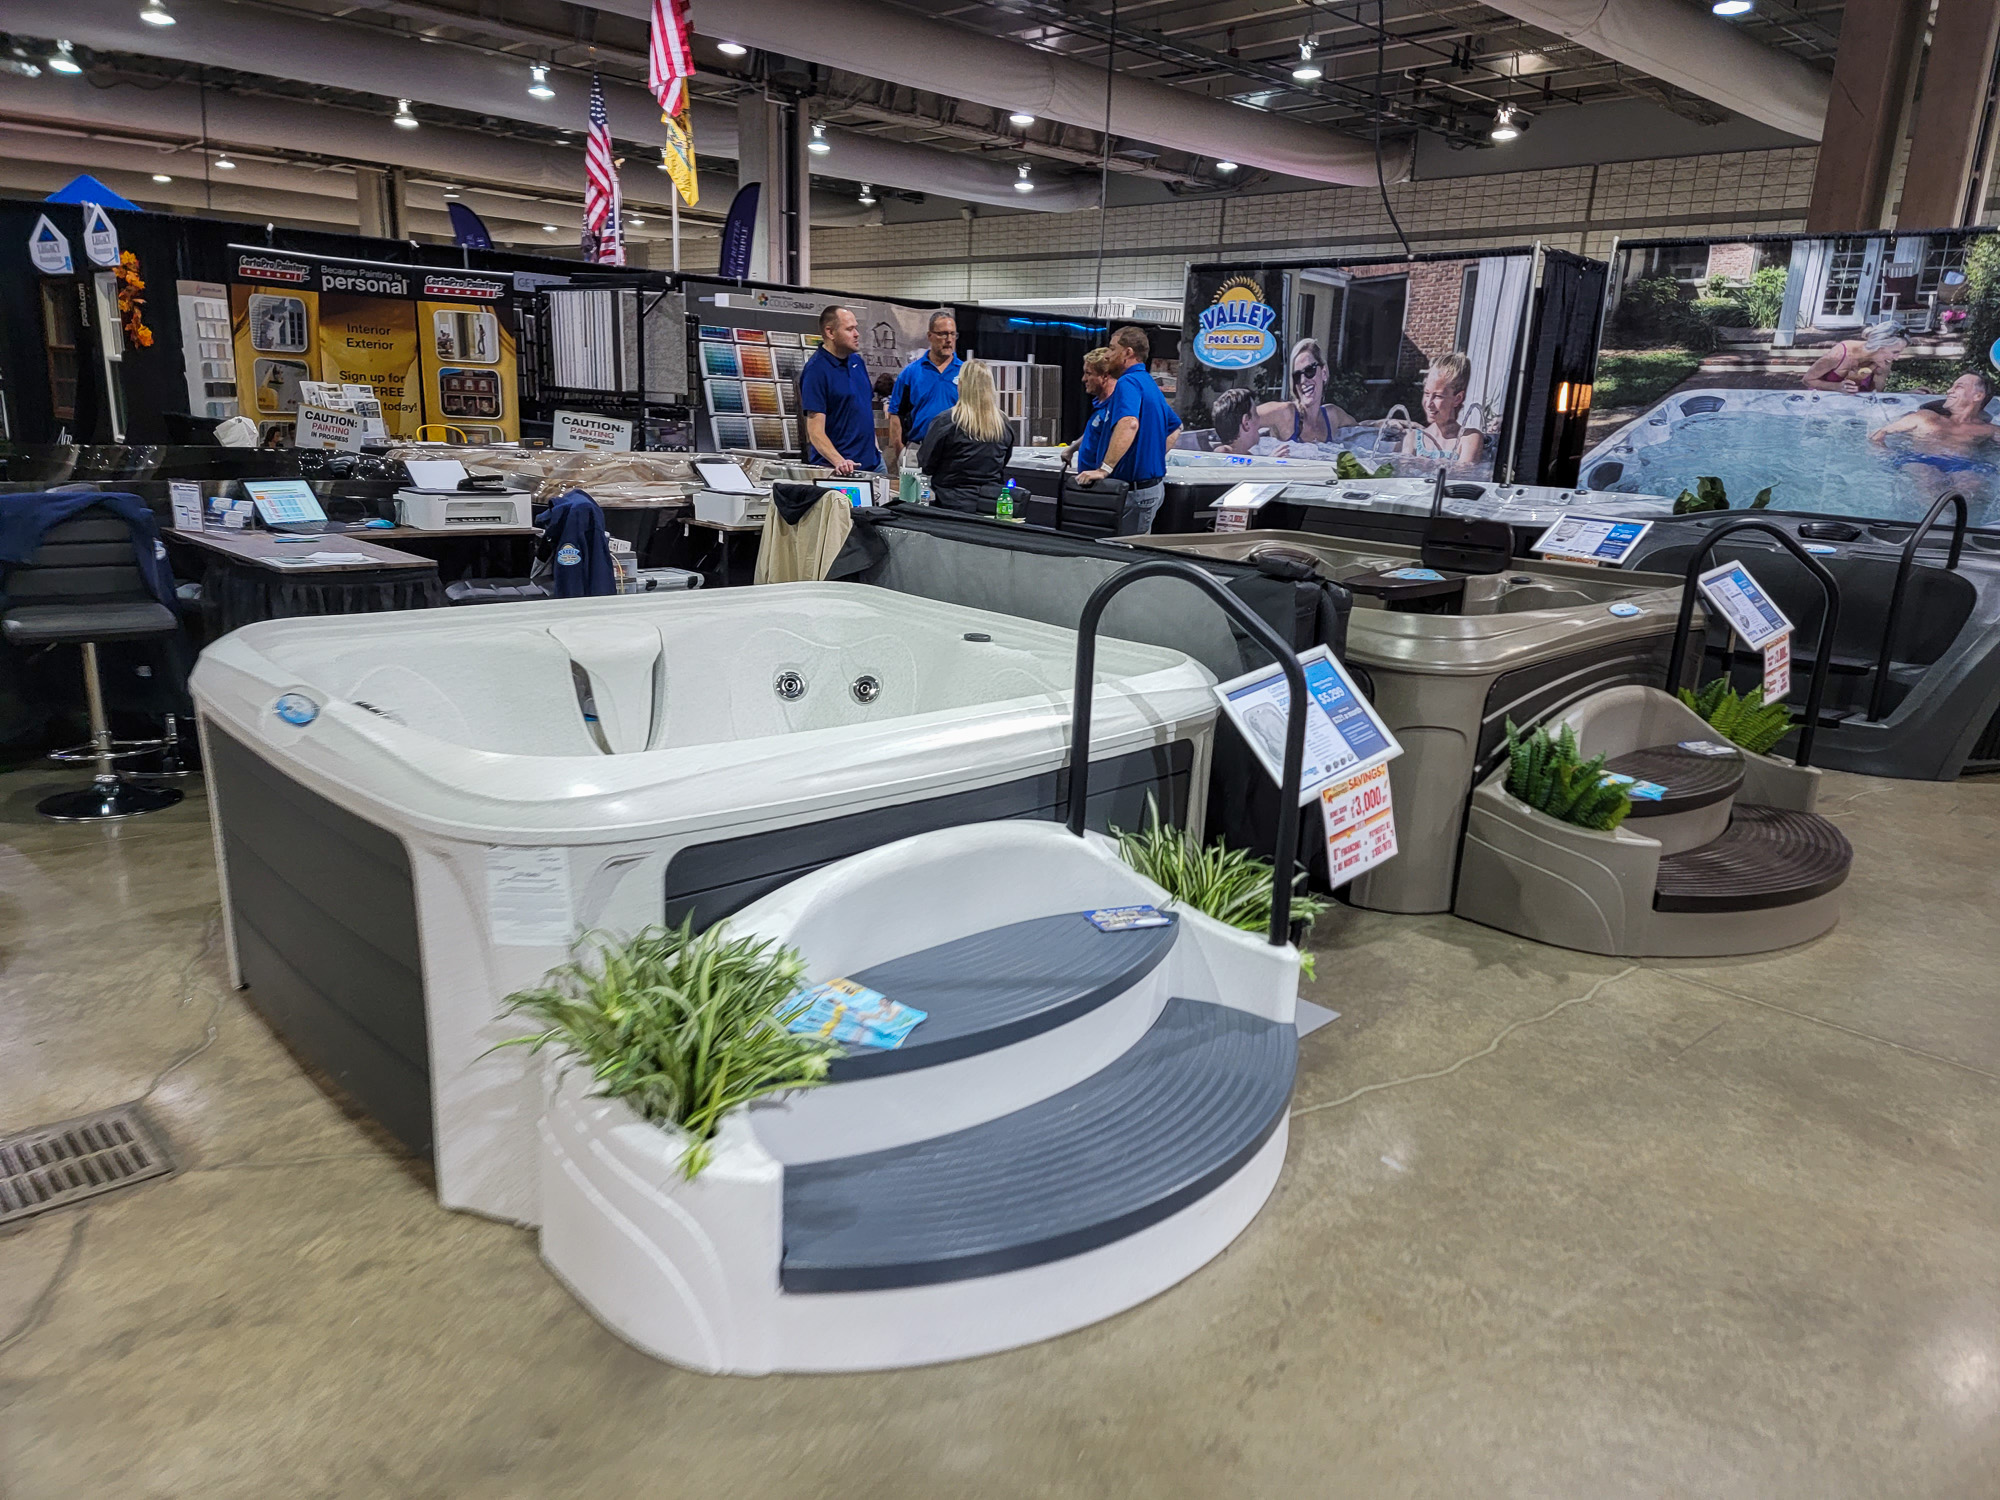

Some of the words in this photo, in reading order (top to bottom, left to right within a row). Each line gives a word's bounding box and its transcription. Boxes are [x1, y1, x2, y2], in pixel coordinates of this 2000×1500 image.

[240, 255, 275, 269] CertaPro
[276, 260, 310, 274] Painters
[321, 265, 358, 276] Because
[359, 269, 393, 281] Painting
[321, 275, 407, 295] personal
[425, 275, 464, 288] CertaPro
[465, 278, 504, 291] Painters
[517, 277, 537, 288] GET
[1202, 302, 1275, 331] VALLEY
[347, 323, 391, 335] Interior
[346, 338, 394, 350] Exterior
[1208, 335, 1230, 344] POOL
[1232, 335, 1240, 344] &
[1242, 335, 1260, 344] SPA
[339, 370, 367, 383] Sign
[370, 374, 385, 384] up
[389, 372, 405, 383] for
[373, 386, 405, 397] FREE
[383, 402, 418, 413] today!
[305, 411, 358, 428] CAUTION:
[562, 417, 625, 433] CAUTION:
[312, 422, 349, 435] PAINTING
[570, 427, 614, 439] PAINTING
[318, 433, 348, 443] PROGRESS
[578, 436, 615, 446] PROGRESS
